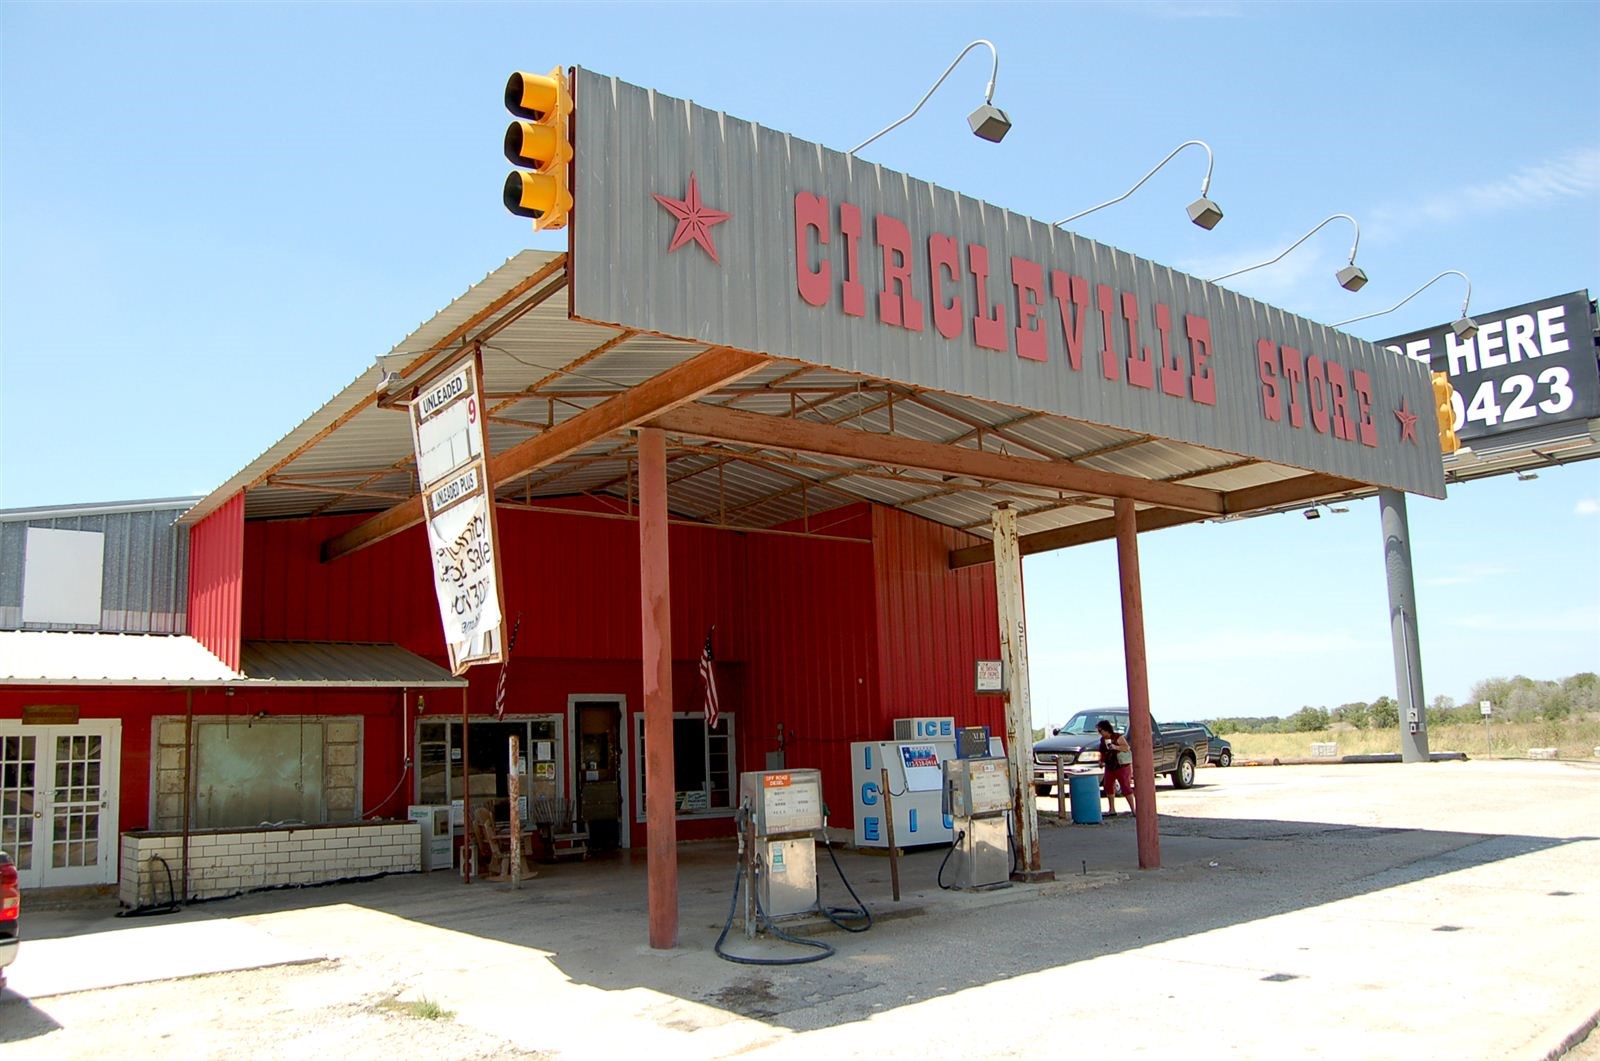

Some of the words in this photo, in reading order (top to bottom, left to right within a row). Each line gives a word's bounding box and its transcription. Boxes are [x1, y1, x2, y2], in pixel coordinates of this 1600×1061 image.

[794, 190, 1217, 406] CIRCLEVILLE
[1256, 337, 1378, 449] STORE
[1445, 305, 1570, 376] HERE
[423, 376, 463, 414] UNLEADED
[468, 397, 476, 424] 9
[435, 482, 460, 508] UNLEADED
[460, 473, 475, 494] PLUS
[917, 720, 952, 737] ICE
[862, 746, 880, 841] ICE
